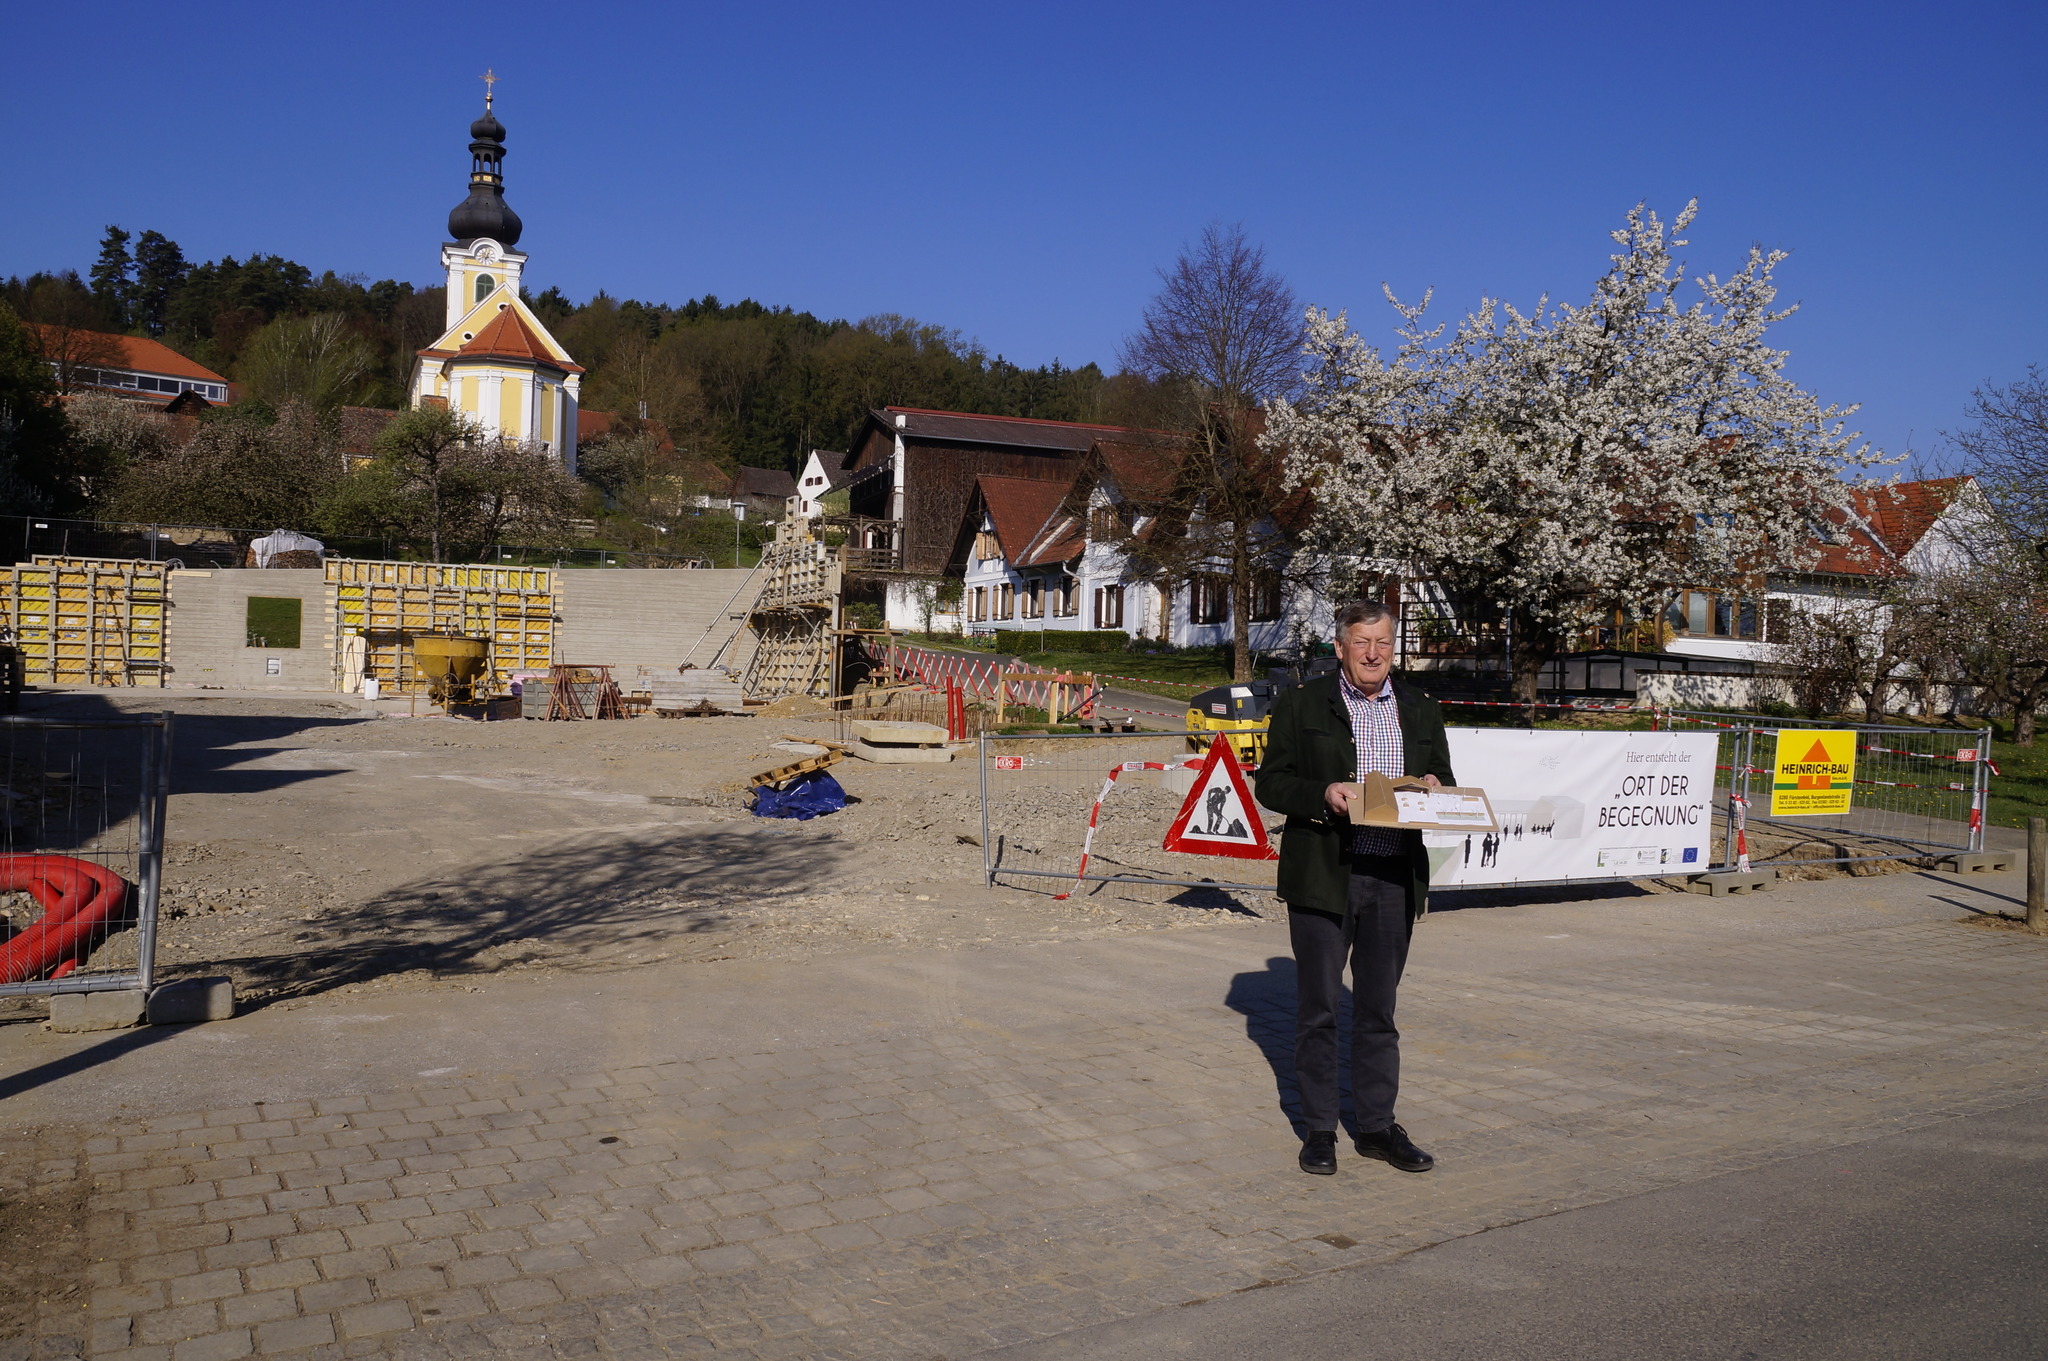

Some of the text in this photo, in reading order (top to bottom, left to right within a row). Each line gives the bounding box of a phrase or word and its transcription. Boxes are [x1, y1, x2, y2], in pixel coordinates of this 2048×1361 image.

[1626, 750, 1692, 763] Hier entsteht der
[1781, 763, 1849, 775] HEINRICH-BAU
[1660, 775, 1689, 796] DER
